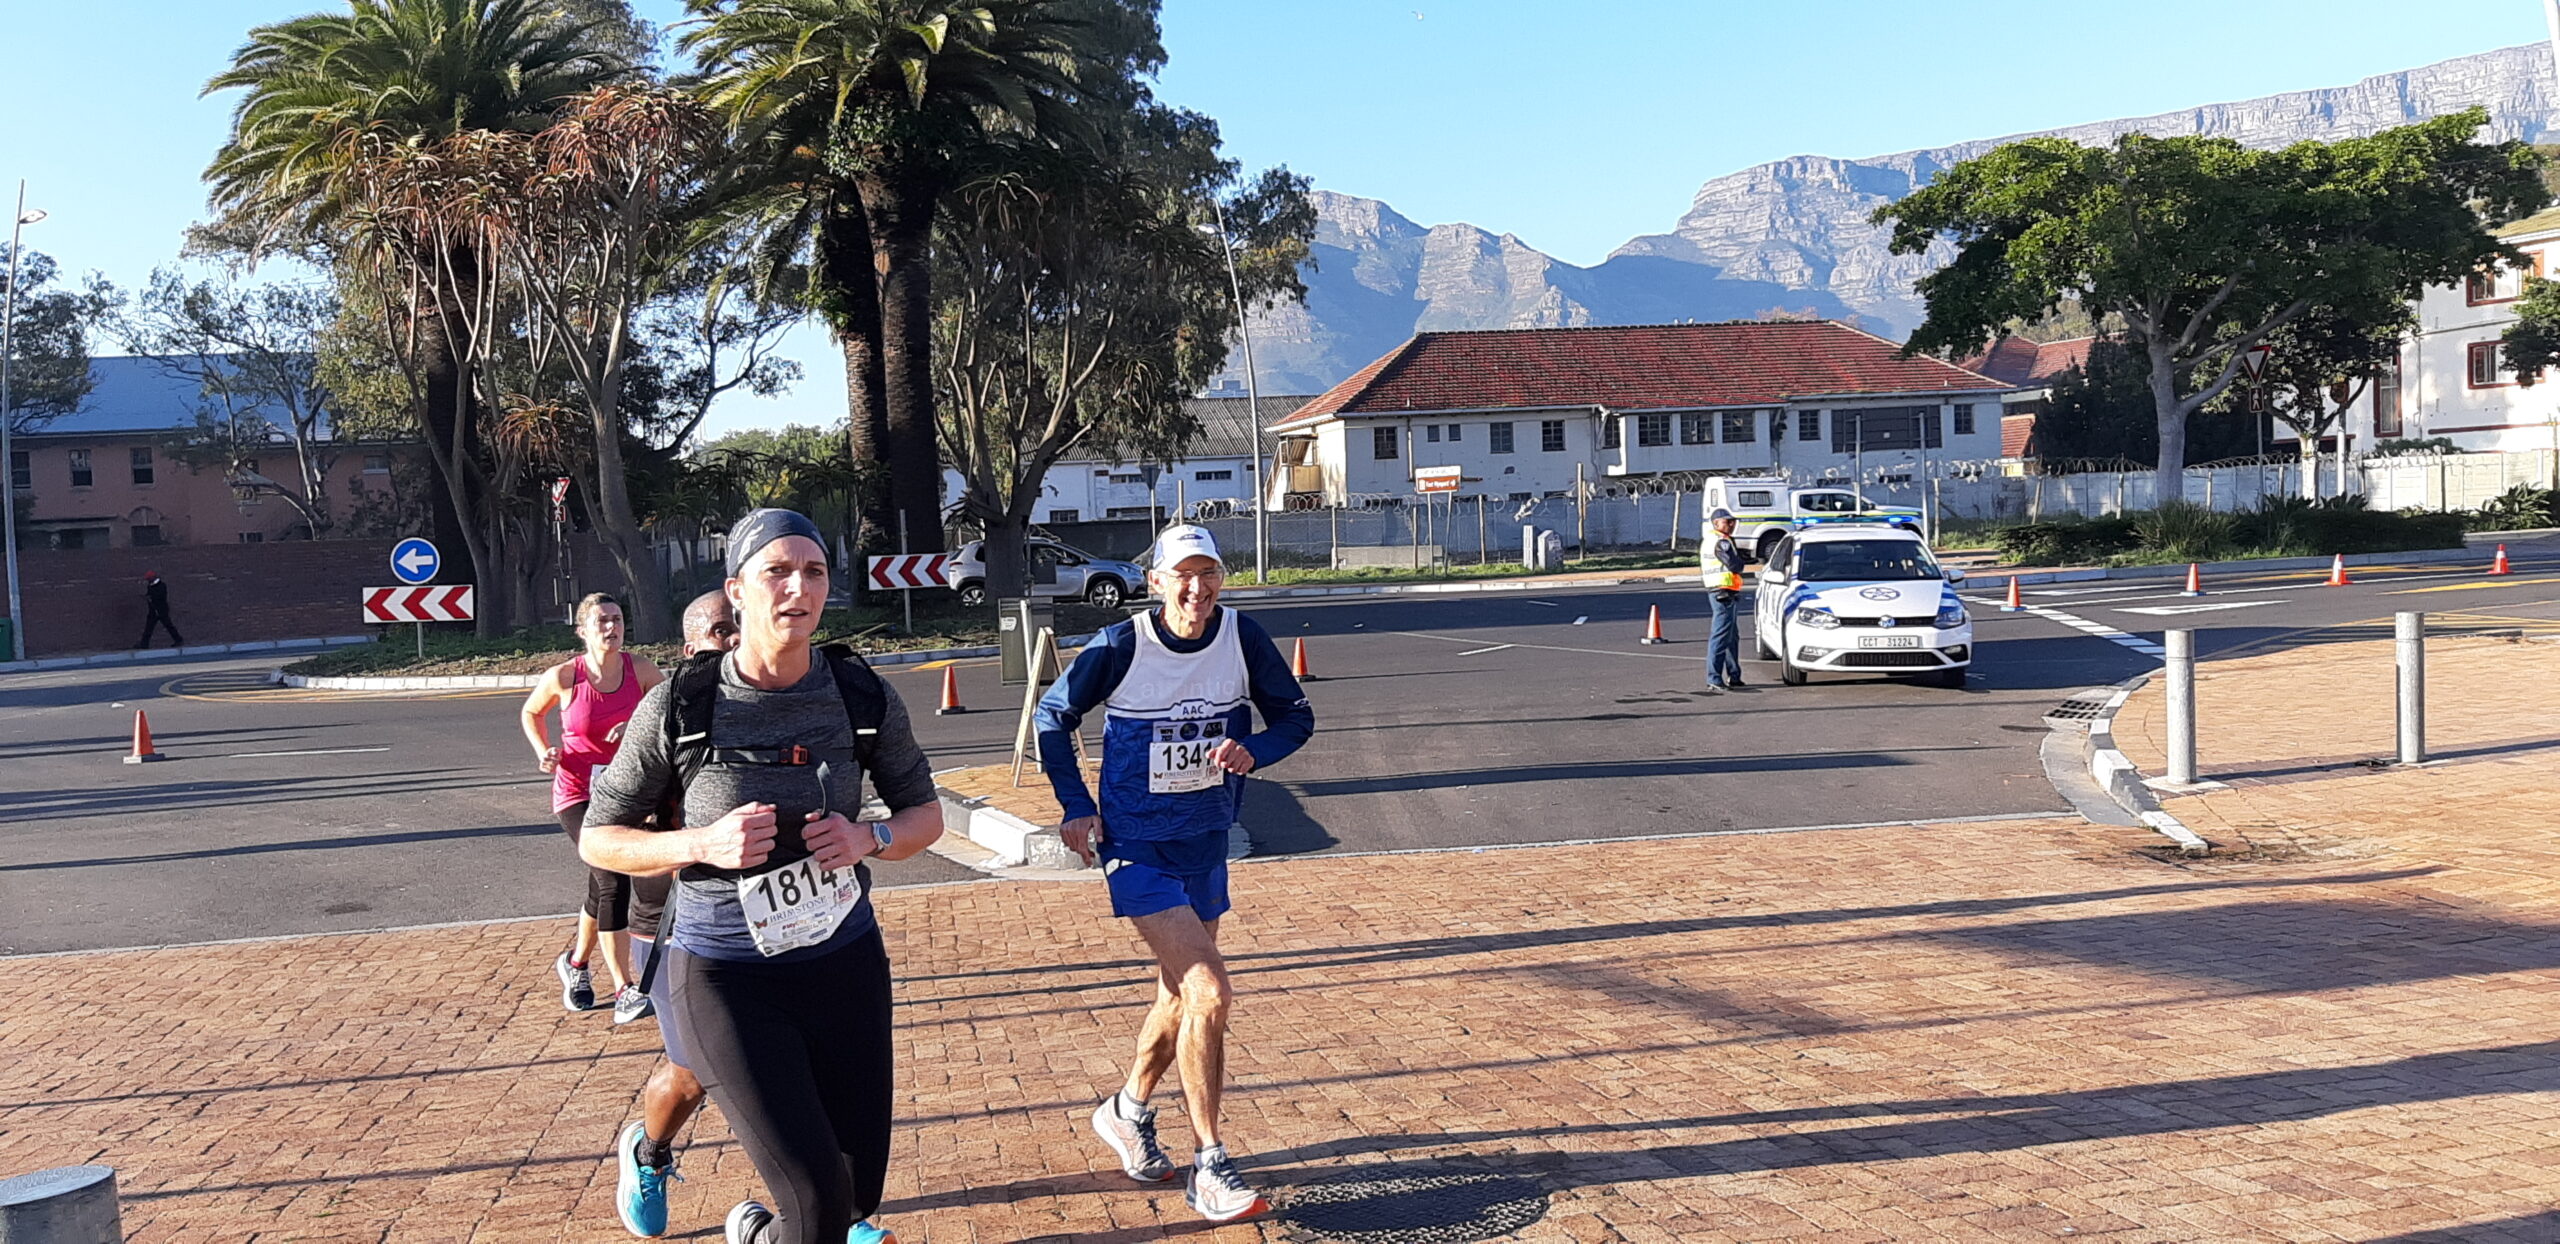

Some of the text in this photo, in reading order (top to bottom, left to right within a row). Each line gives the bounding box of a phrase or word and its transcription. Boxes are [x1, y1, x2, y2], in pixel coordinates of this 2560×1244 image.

[1863, 637, 1913, 647] CCT 31224
[1182, 705, 1204, 715] AAC
[758, 861, 838, 912] 1814
[769, 895, 827, 923] BRIMSTONE
